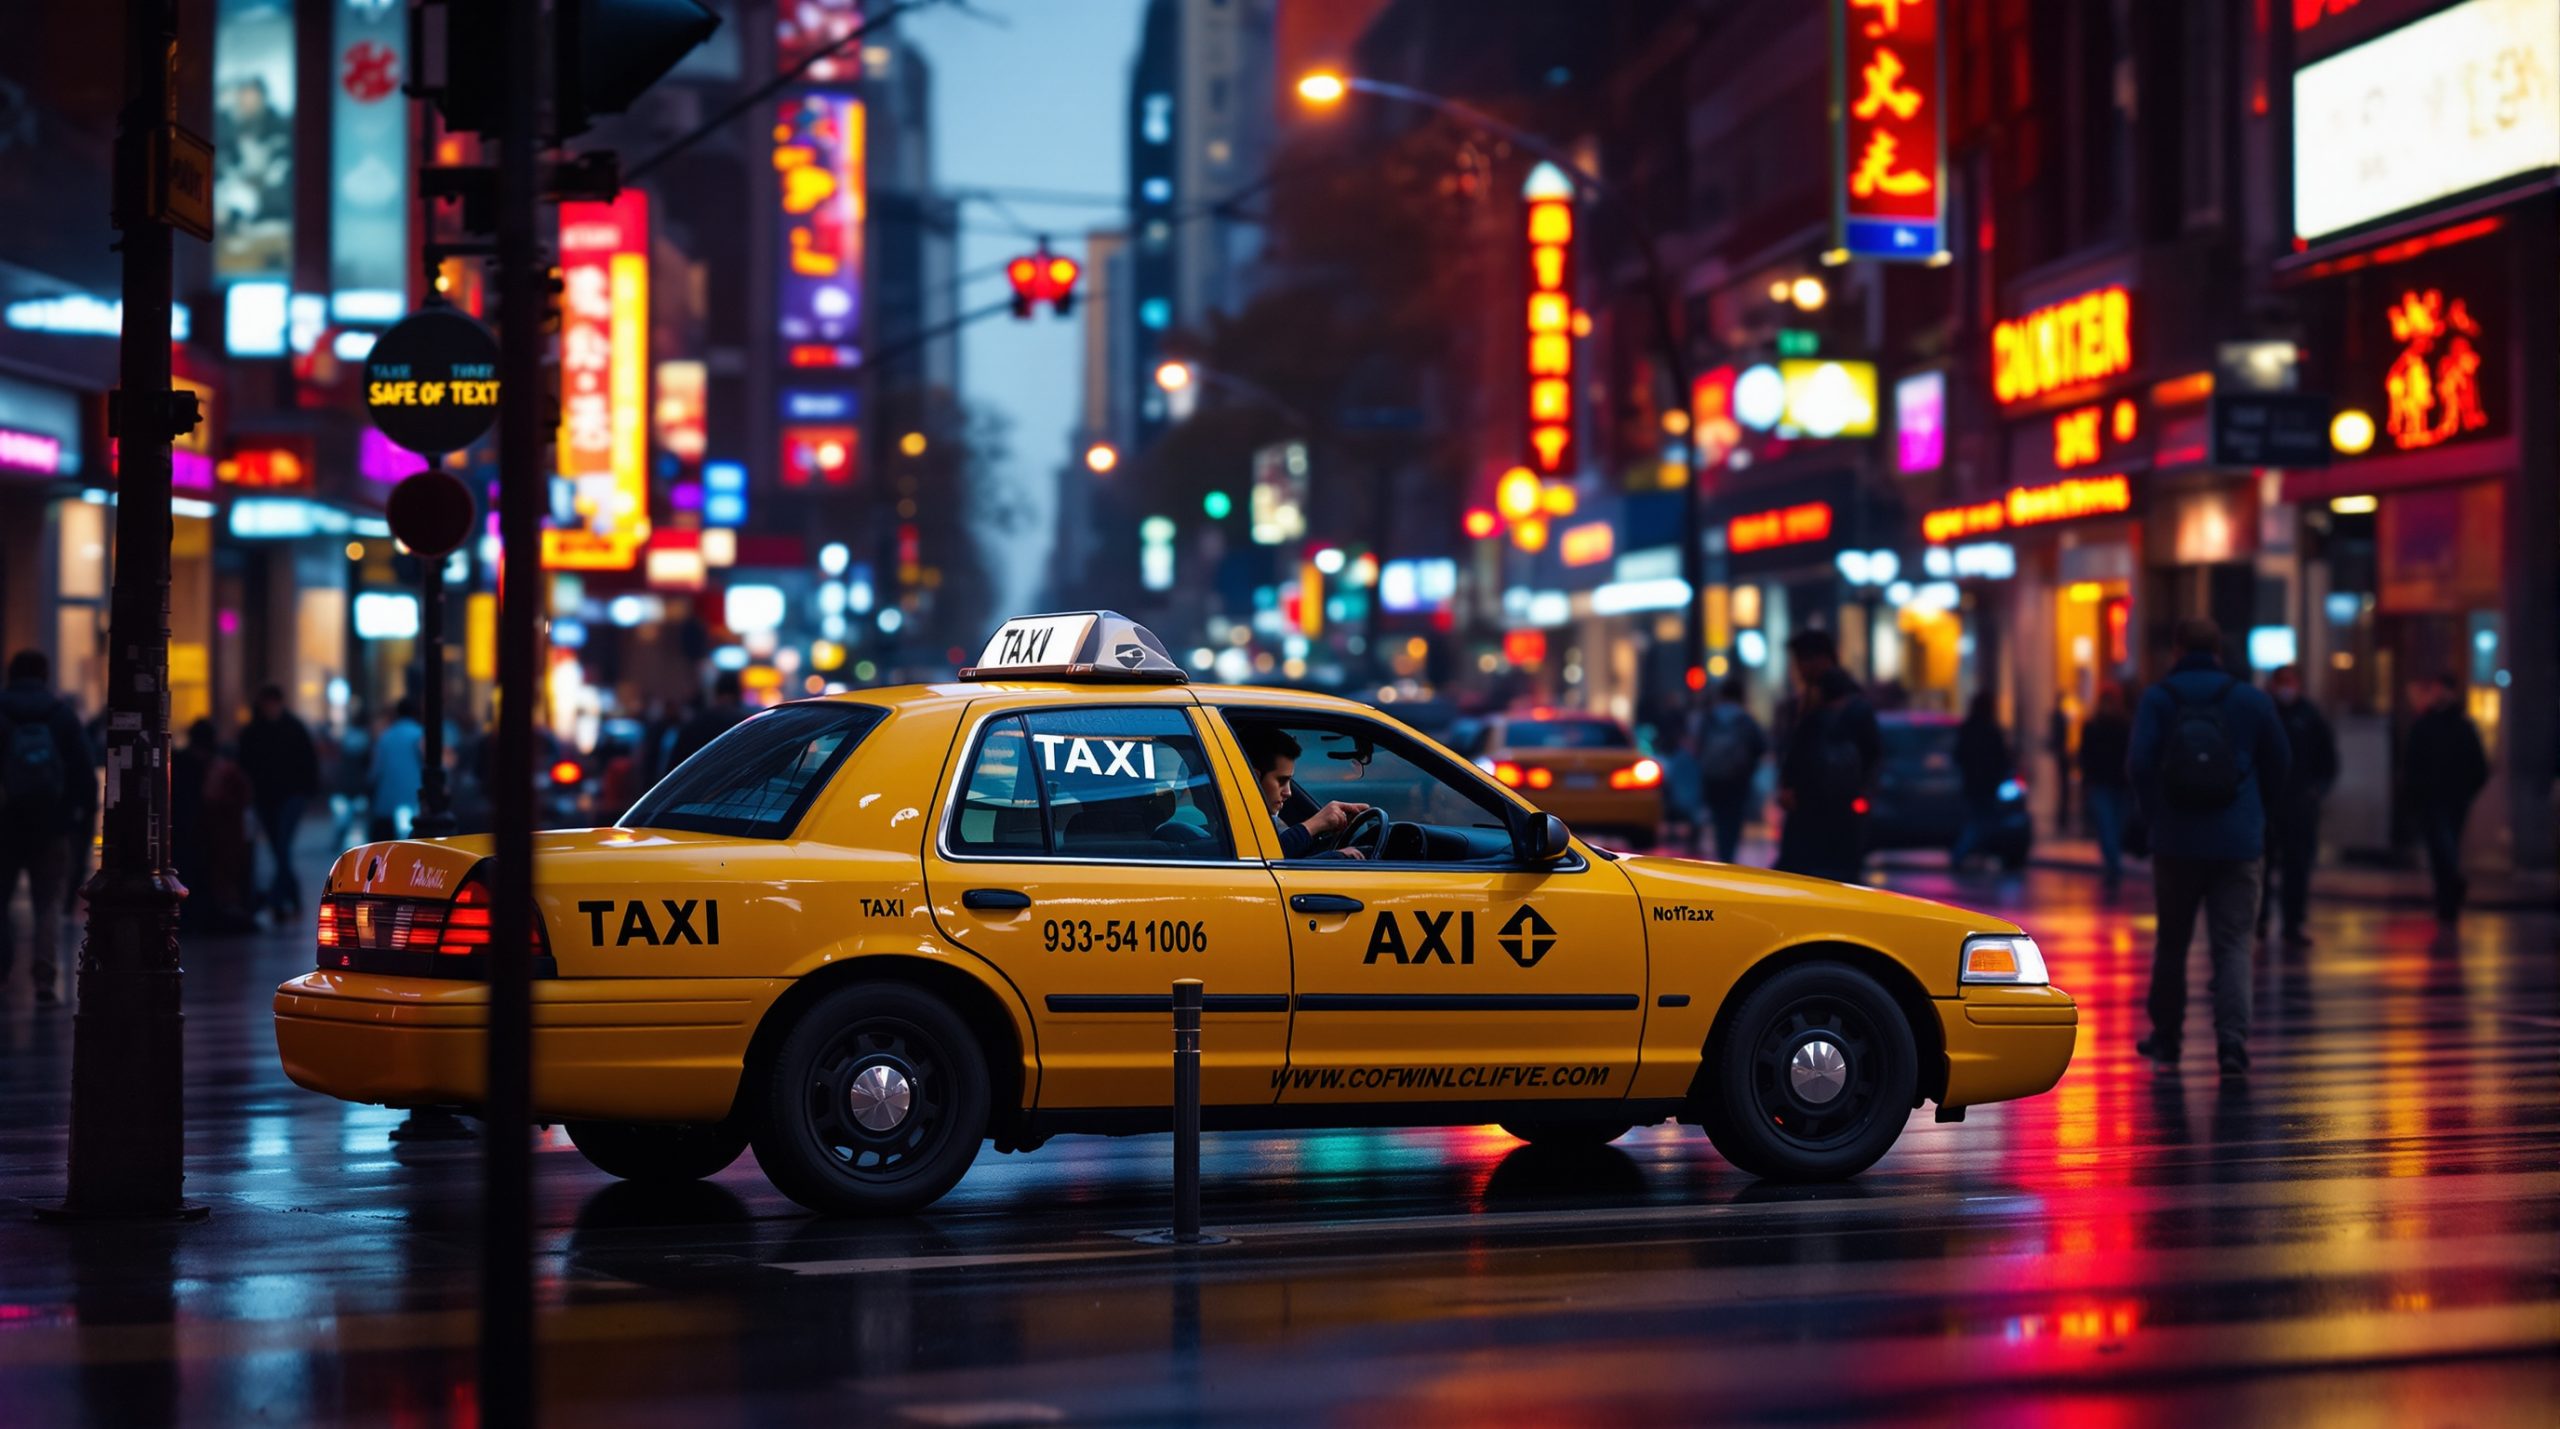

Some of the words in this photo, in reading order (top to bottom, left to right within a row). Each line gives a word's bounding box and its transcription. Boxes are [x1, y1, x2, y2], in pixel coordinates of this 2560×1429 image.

[369, 381, 418, 405] SAFE
[420, 381, 446, 405] OF
[448, 381, 501, 405] TEXT
[1033, 733, 1156, 779] TAXI
[578, 900, 719, 947] TAXI
[860, 899, 904, 917] TAXI
[1043, 919, 1139, 952] 933-54
[1145, 920, 1207, 952] 1006
[1362, 911, 1474, 964] AXI
